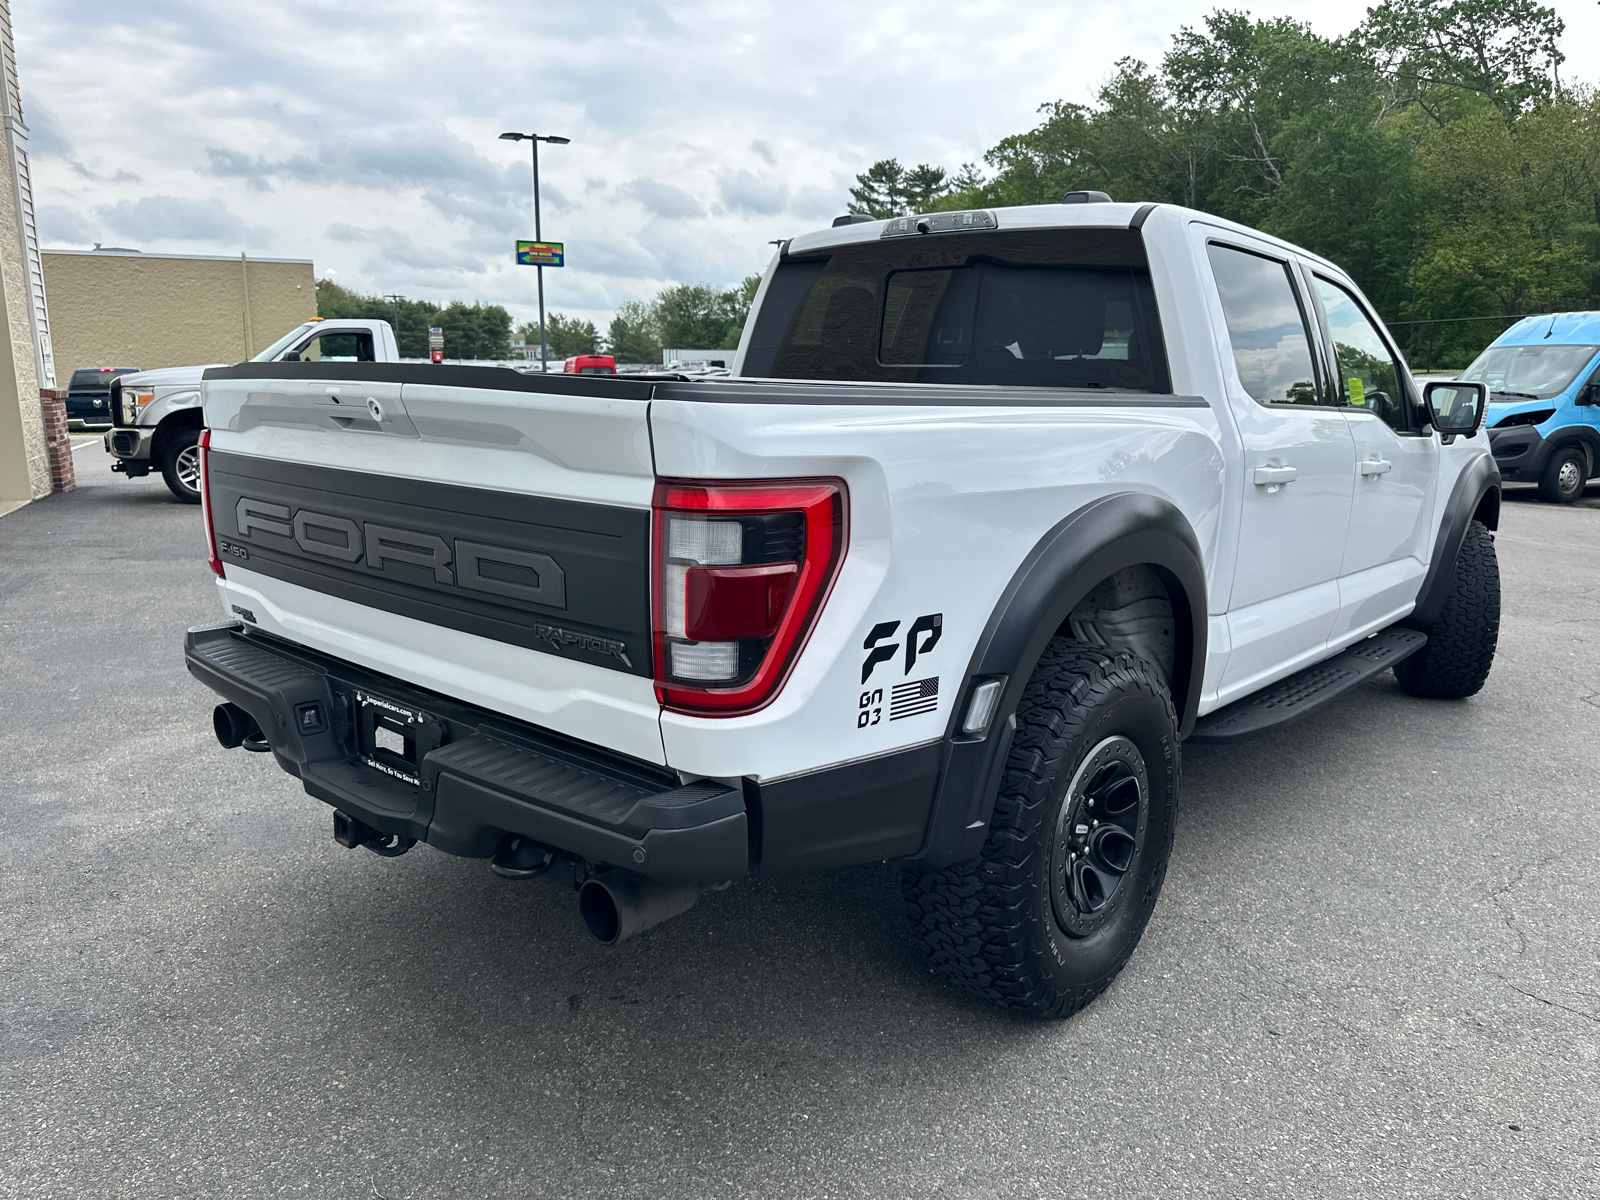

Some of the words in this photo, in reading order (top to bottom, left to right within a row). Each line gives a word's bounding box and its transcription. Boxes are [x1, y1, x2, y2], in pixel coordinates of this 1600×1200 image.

[220, 541, 248, 560] F-150
[236, 495, 566, 610] FORD
[534, 622, 632, 668] RAPTOR
[368, 759, 376, 768] Sell
[375, 762, 388, 774] More,
[388, 768, 394, 776] So
[394, 770, 403, 779] You
[403, 774, 414, 784] Save
